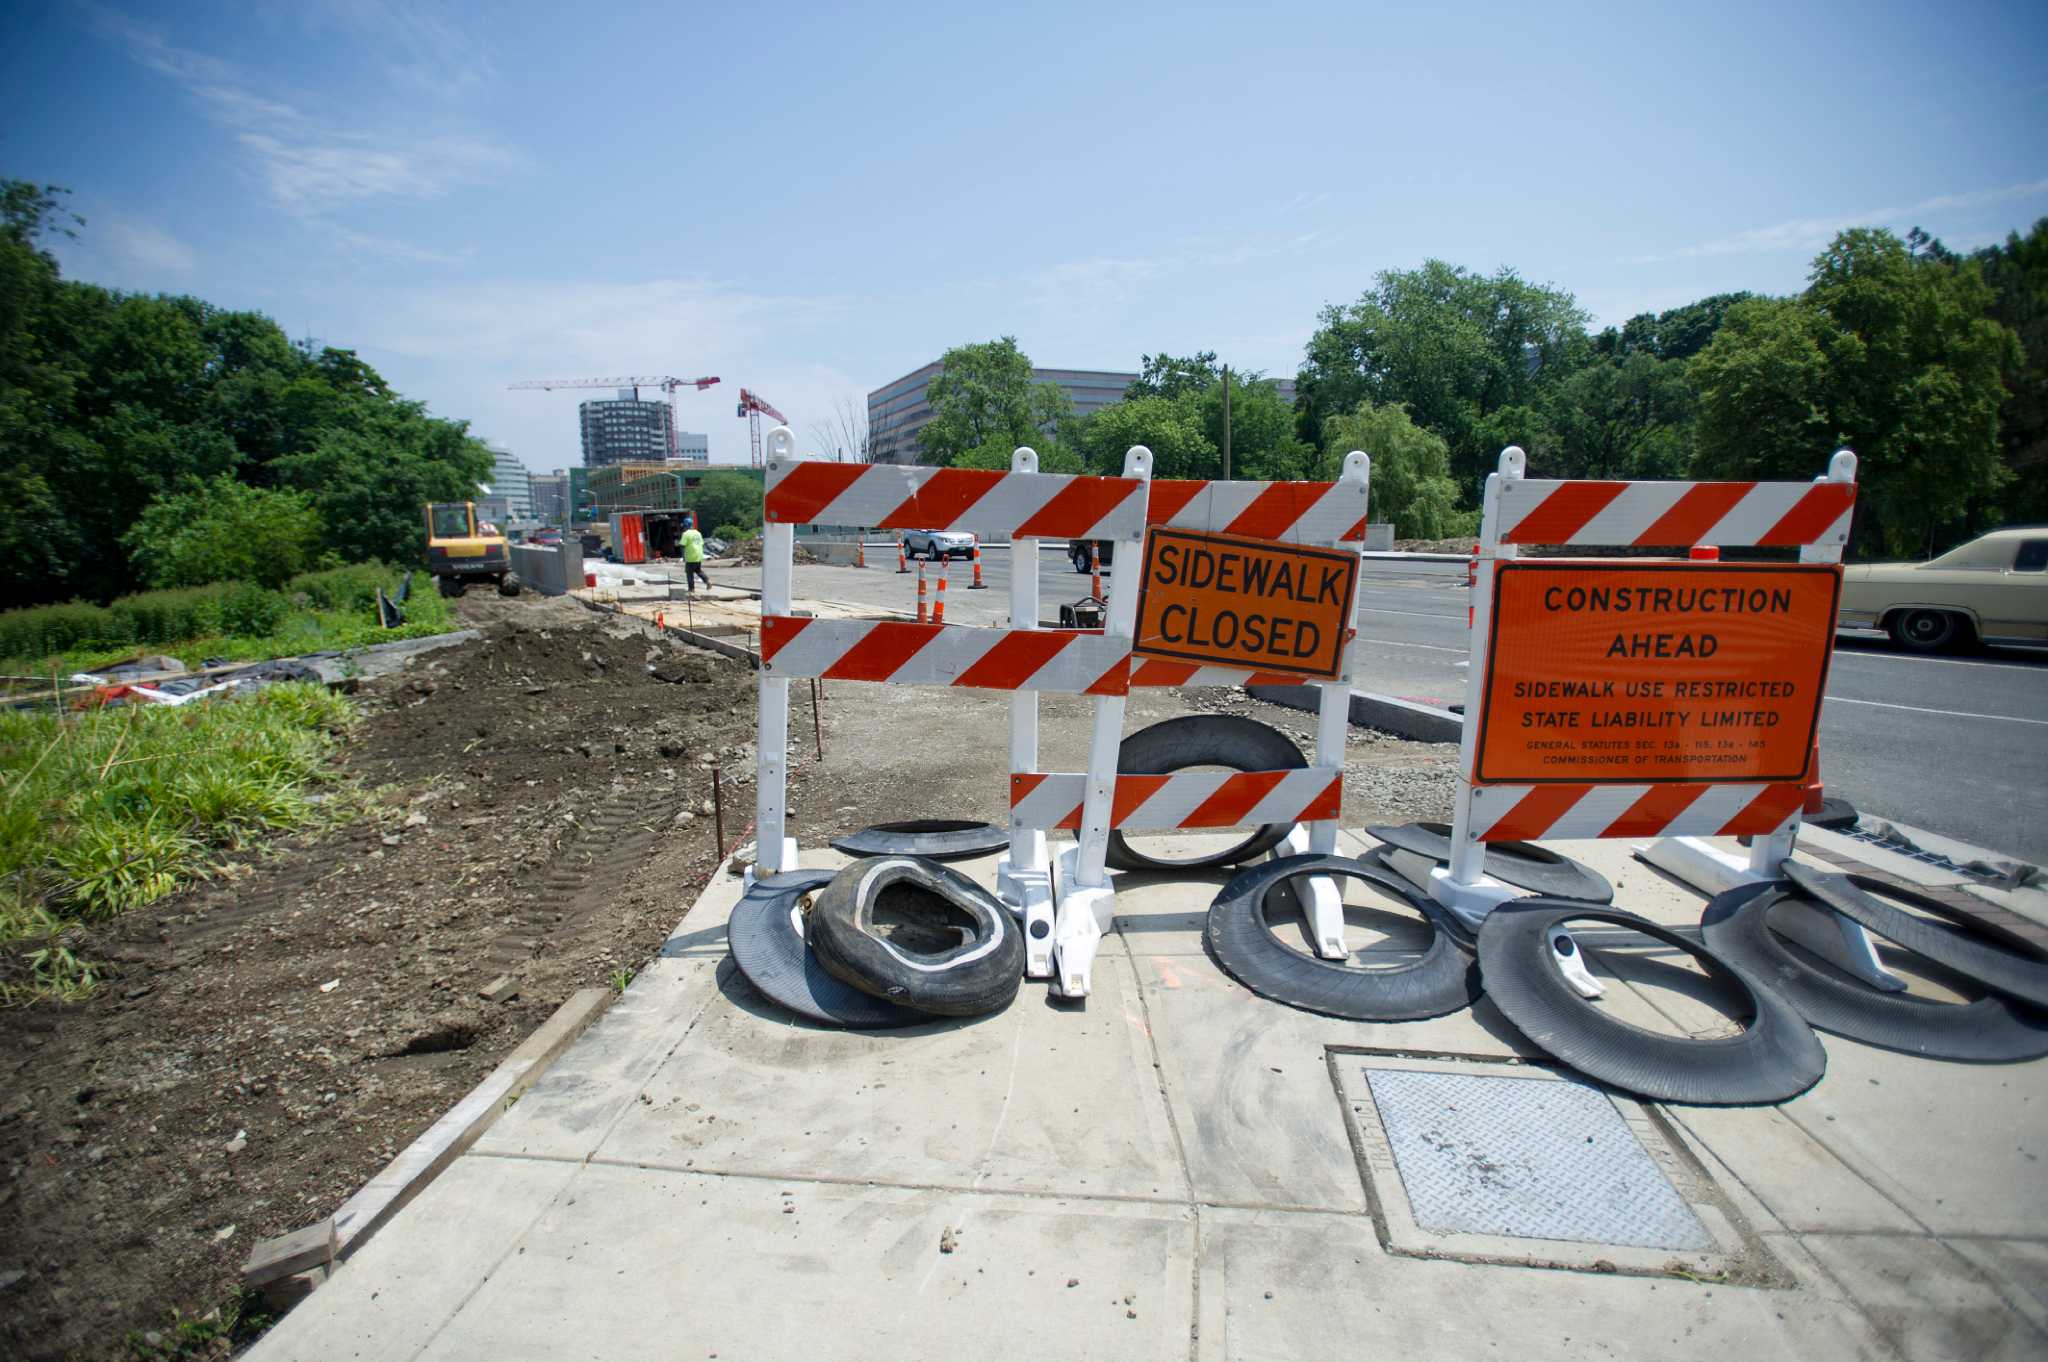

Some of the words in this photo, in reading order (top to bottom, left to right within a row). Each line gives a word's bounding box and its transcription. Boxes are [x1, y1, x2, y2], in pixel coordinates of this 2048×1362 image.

[1154, 544, 1345, 606] SIDEWALK
[1544, 586, 1792, 614] CONSTRUCTION
[1159, 603, 1321, 659] CLOSED
[1606, 634, 1719, 659] AHEAD
[1513, 681, 1615, 699] SIDEWALK
[1625, 682, 1665, 698] USE
[1675, 681, 1795, 698] RESTRICTED
[1521, 711, 1580, 728] STATE
[1591, 711, 1691, 728] LIABILITY
[1700, 711, 1780, 727] LIMITED
[1526, 740, 1577, 751] GENERAL
[1581, 740, 1631, 750] STATUTES
[1543, 755, 1630, 765] COMMISSIONER
[1634, 755, 1649, 764] OF
[1654, 754, 1747, 764] TRANSPORTATION
